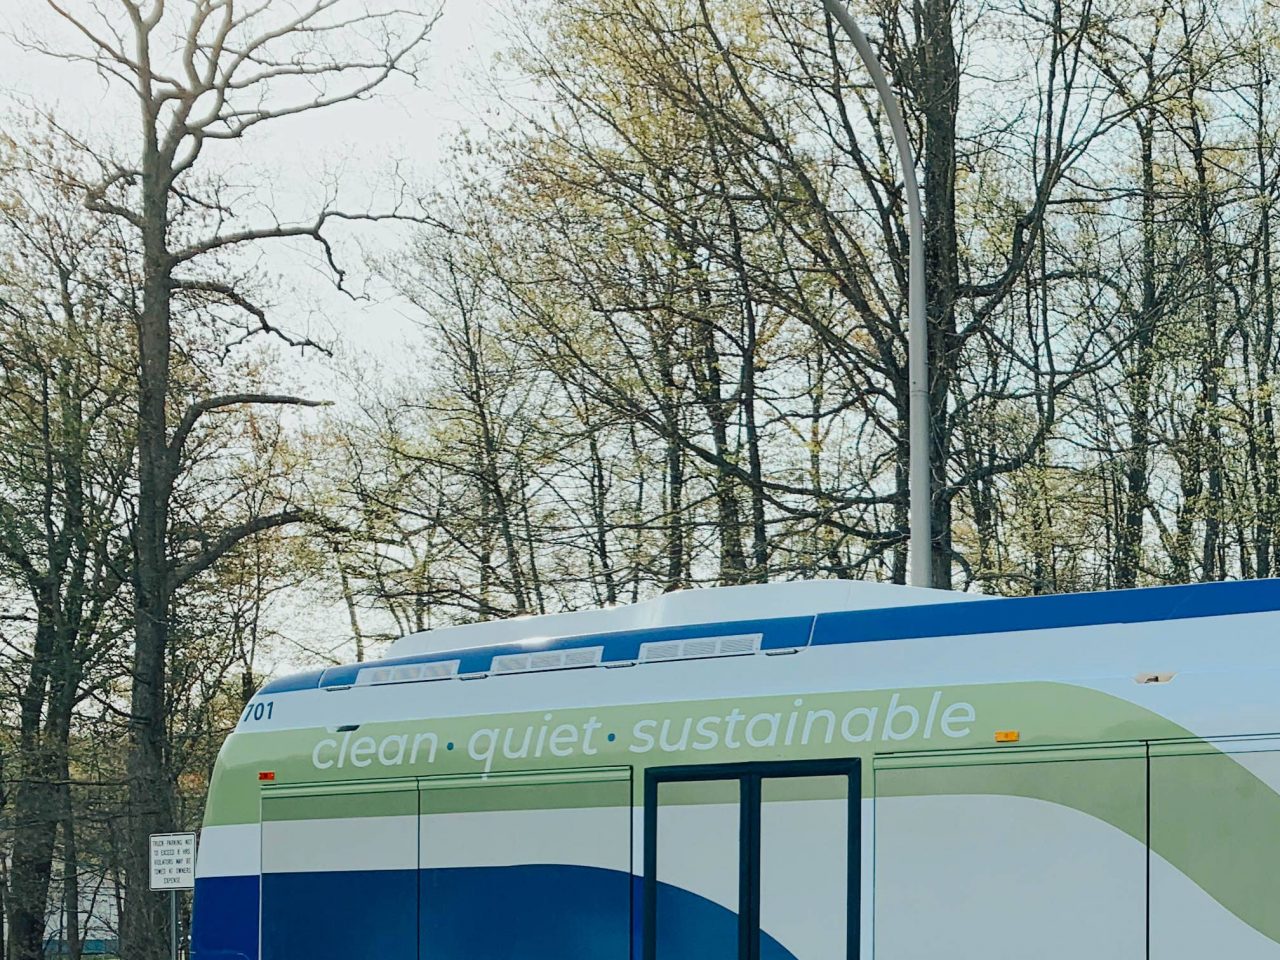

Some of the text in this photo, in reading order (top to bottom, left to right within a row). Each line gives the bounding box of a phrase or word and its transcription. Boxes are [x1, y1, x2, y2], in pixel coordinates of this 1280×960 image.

[243, 701, 275, 722] 701
[311, 691, 977, 781] clean quiet sustainable
